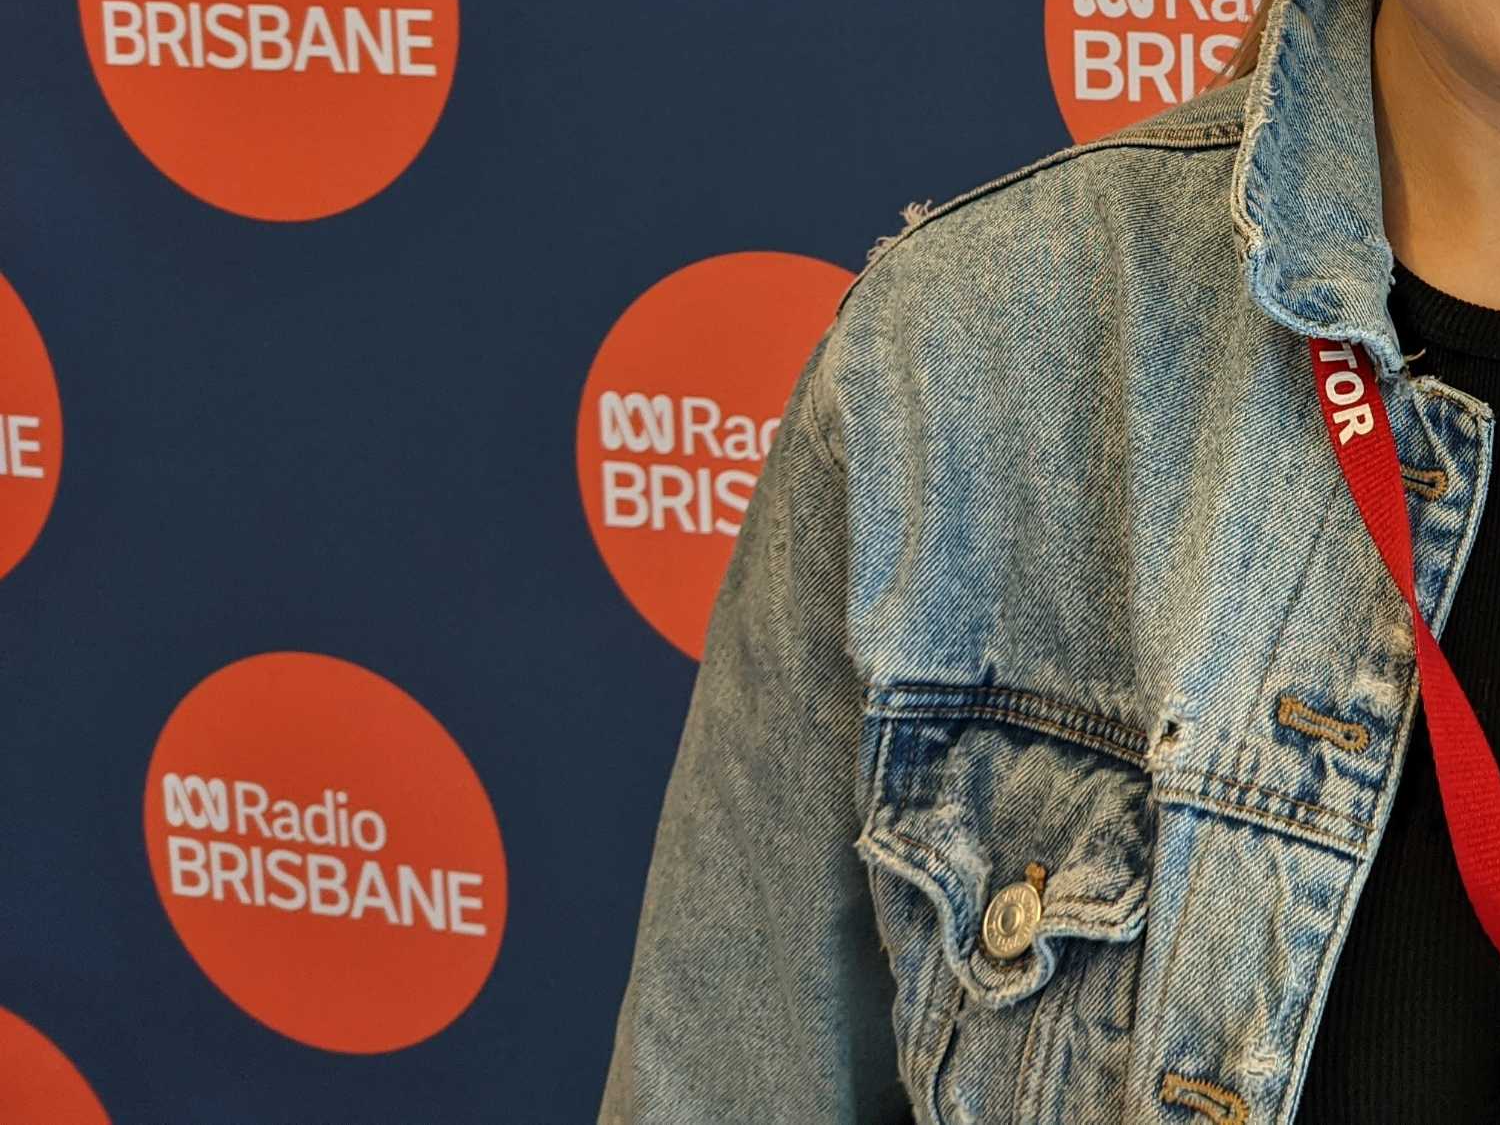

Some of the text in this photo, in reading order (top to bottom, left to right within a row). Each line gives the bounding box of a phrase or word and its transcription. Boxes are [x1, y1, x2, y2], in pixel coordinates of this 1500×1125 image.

[102, 0, 436, 75] BRISBANE
[235, 782, 385, 851] Radio
[168, 836, 486, 935] BRISBANE
